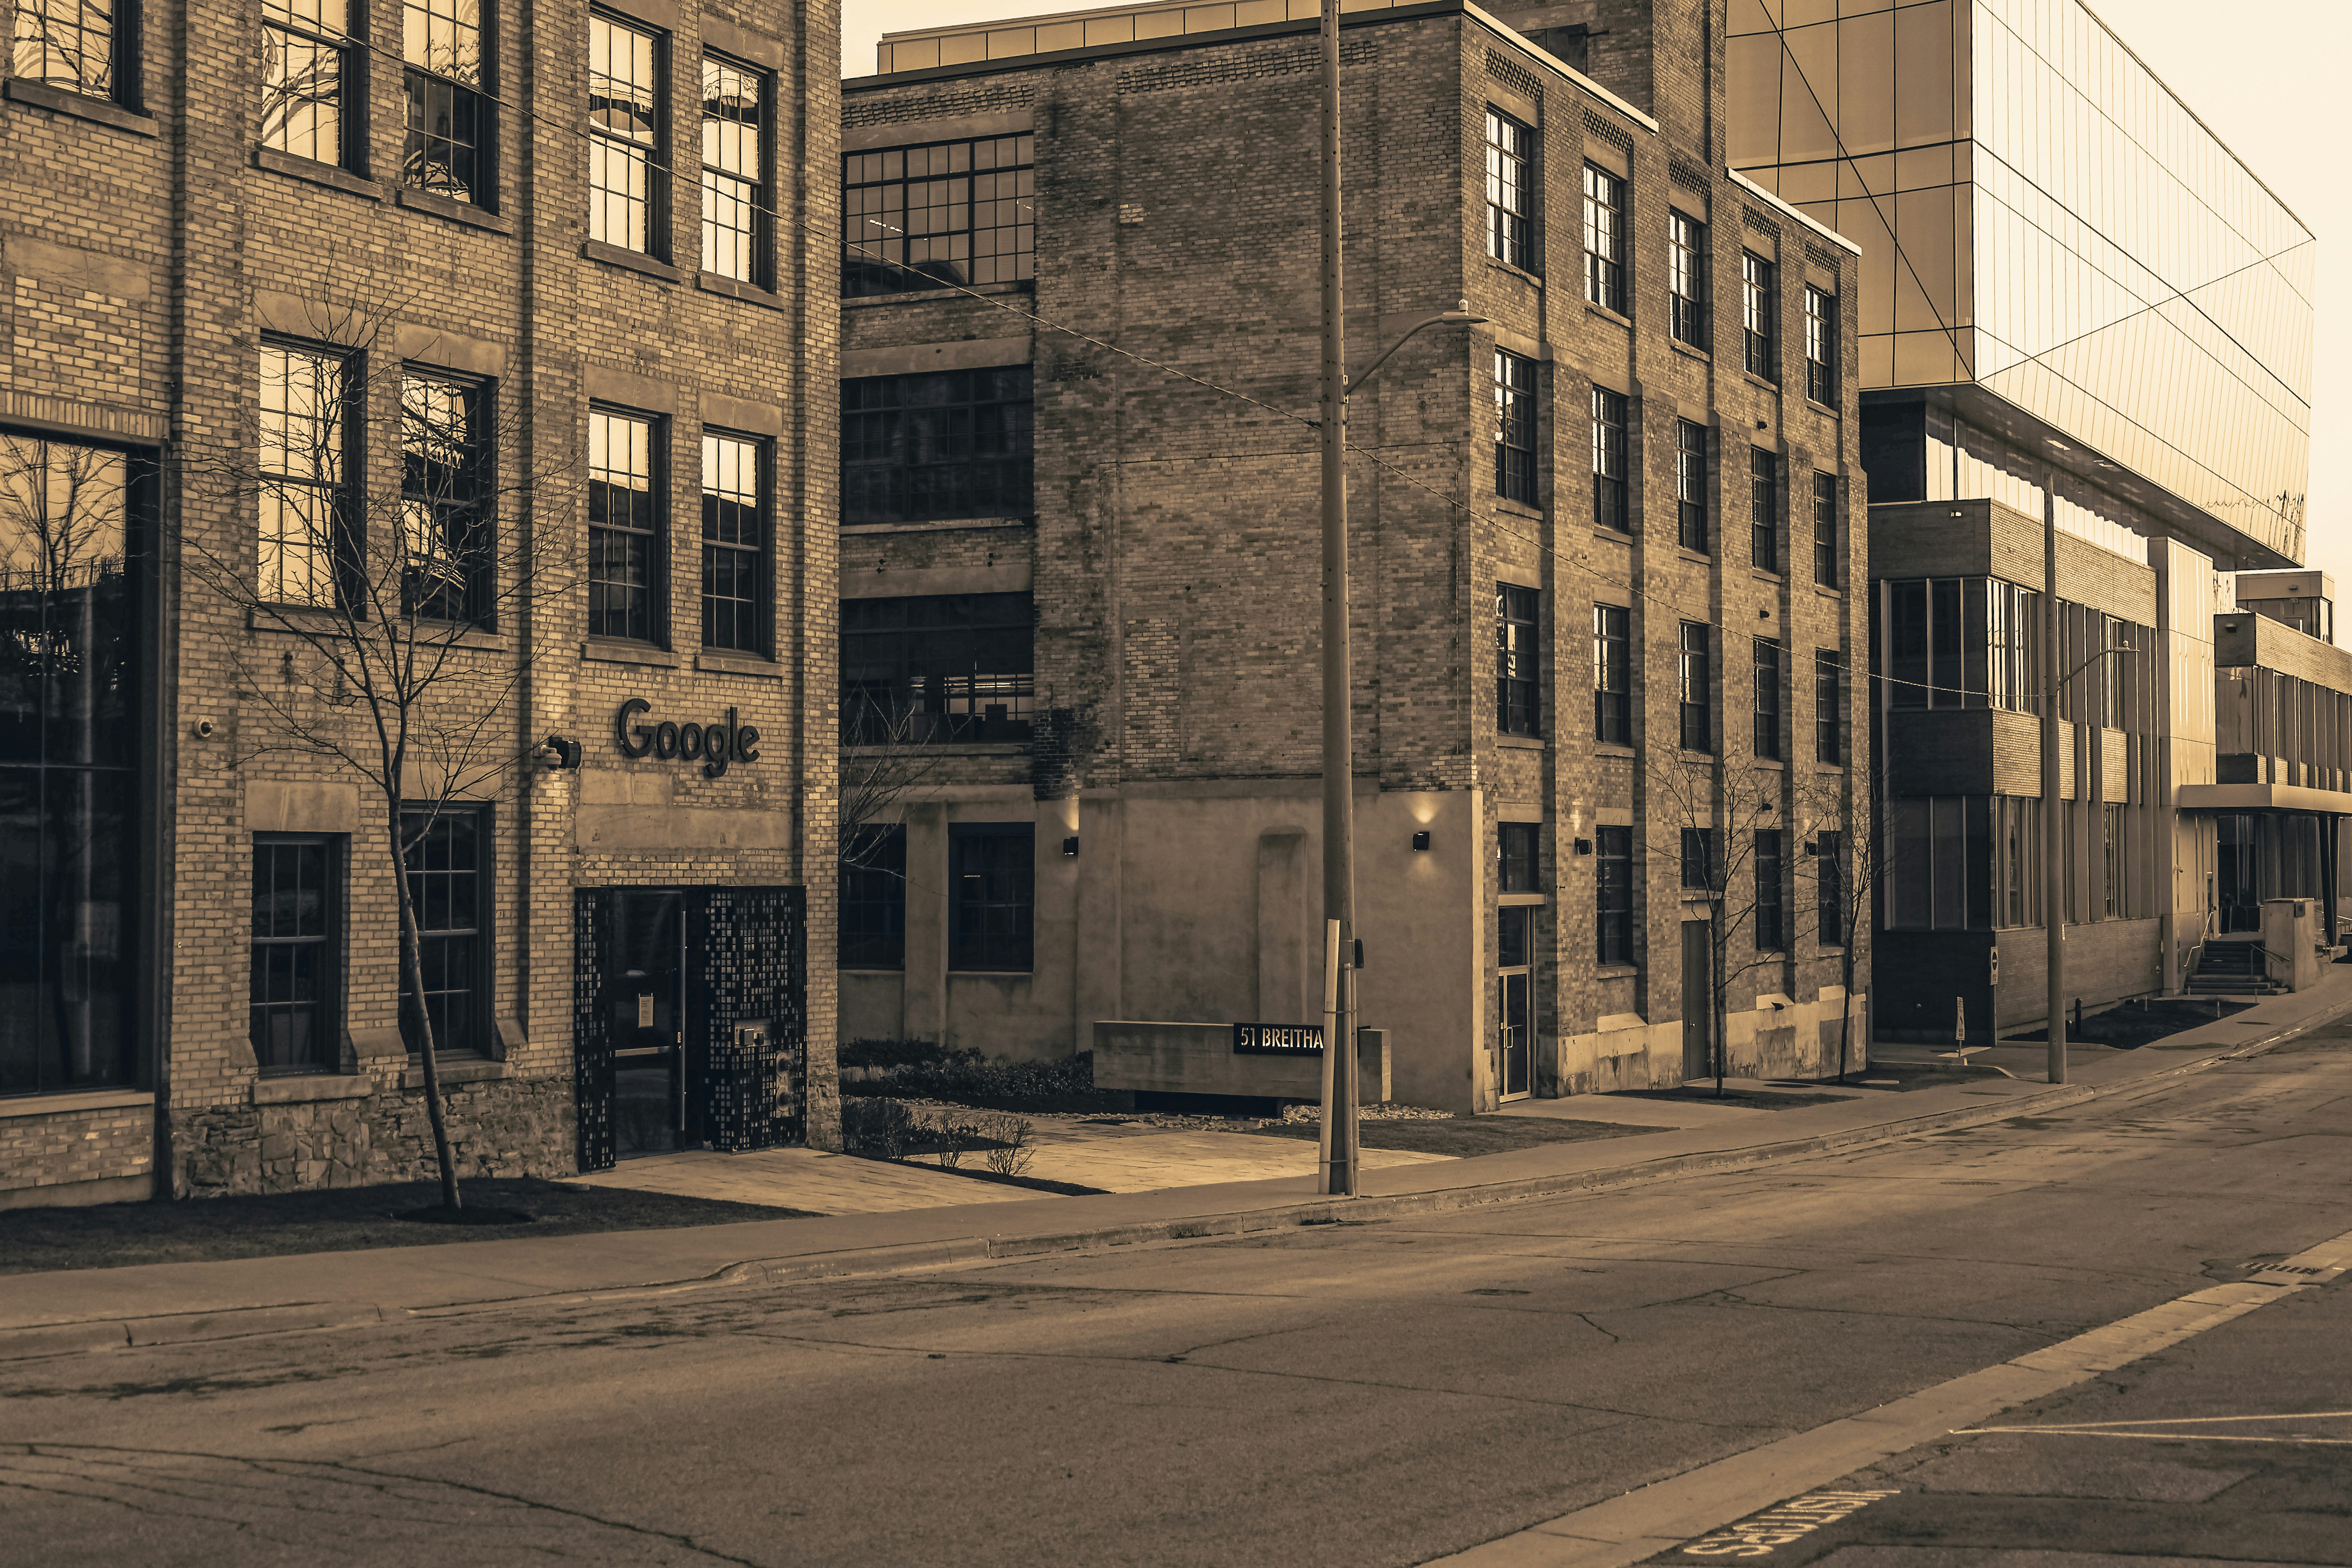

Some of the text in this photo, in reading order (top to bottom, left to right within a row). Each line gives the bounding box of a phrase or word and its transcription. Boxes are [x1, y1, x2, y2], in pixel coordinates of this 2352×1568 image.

[618, 698, 760, 777] Google
[1241, 1027, 1324, 1048] 51 BREITHA
[1683, 1489, 1901, 1557] VISITORS
